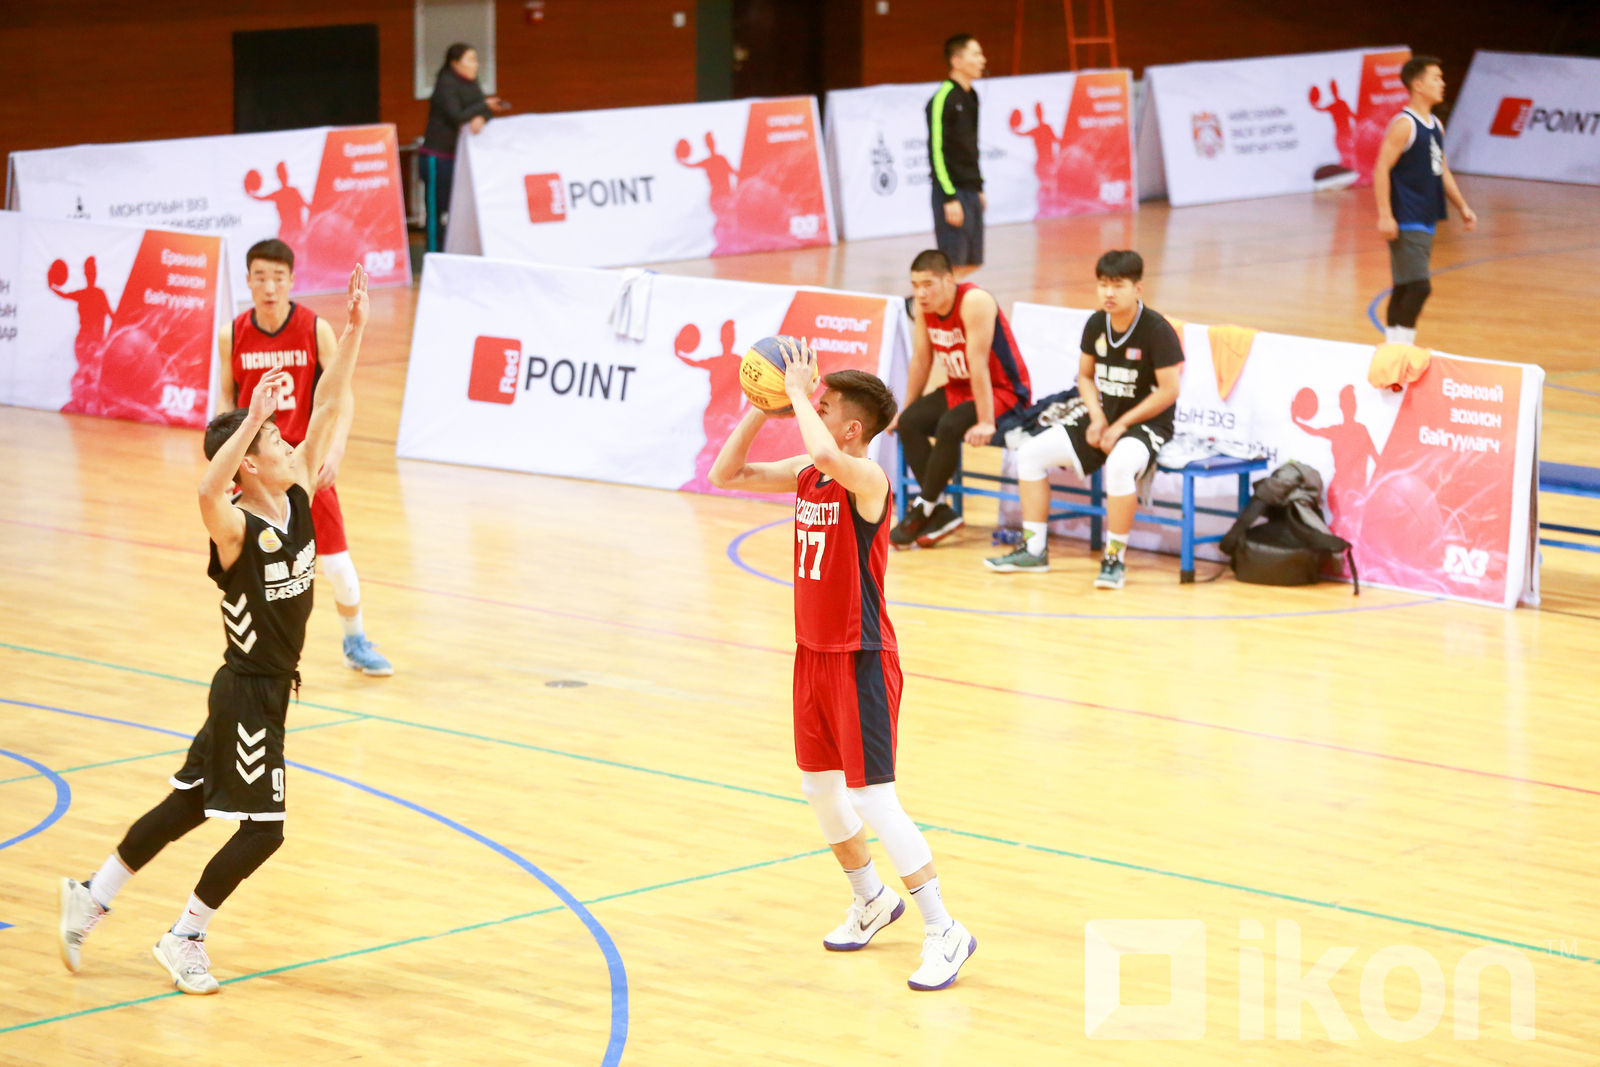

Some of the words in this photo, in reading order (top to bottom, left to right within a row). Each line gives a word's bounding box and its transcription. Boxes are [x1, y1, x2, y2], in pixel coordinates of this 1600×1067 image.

[569, 176, 656, 209] POINT
[499, 348, 520, 394] Red
[525, 356, 637, 402] POINT
[1442, 377, 1505, 404] Ерөнхий
[1449, 406, 1503, 429] зохион
[1418, 425, 1501, 455] байгуулагч
[796, 528, 827, 582] 77
[271, 767, 285, 803] 9
